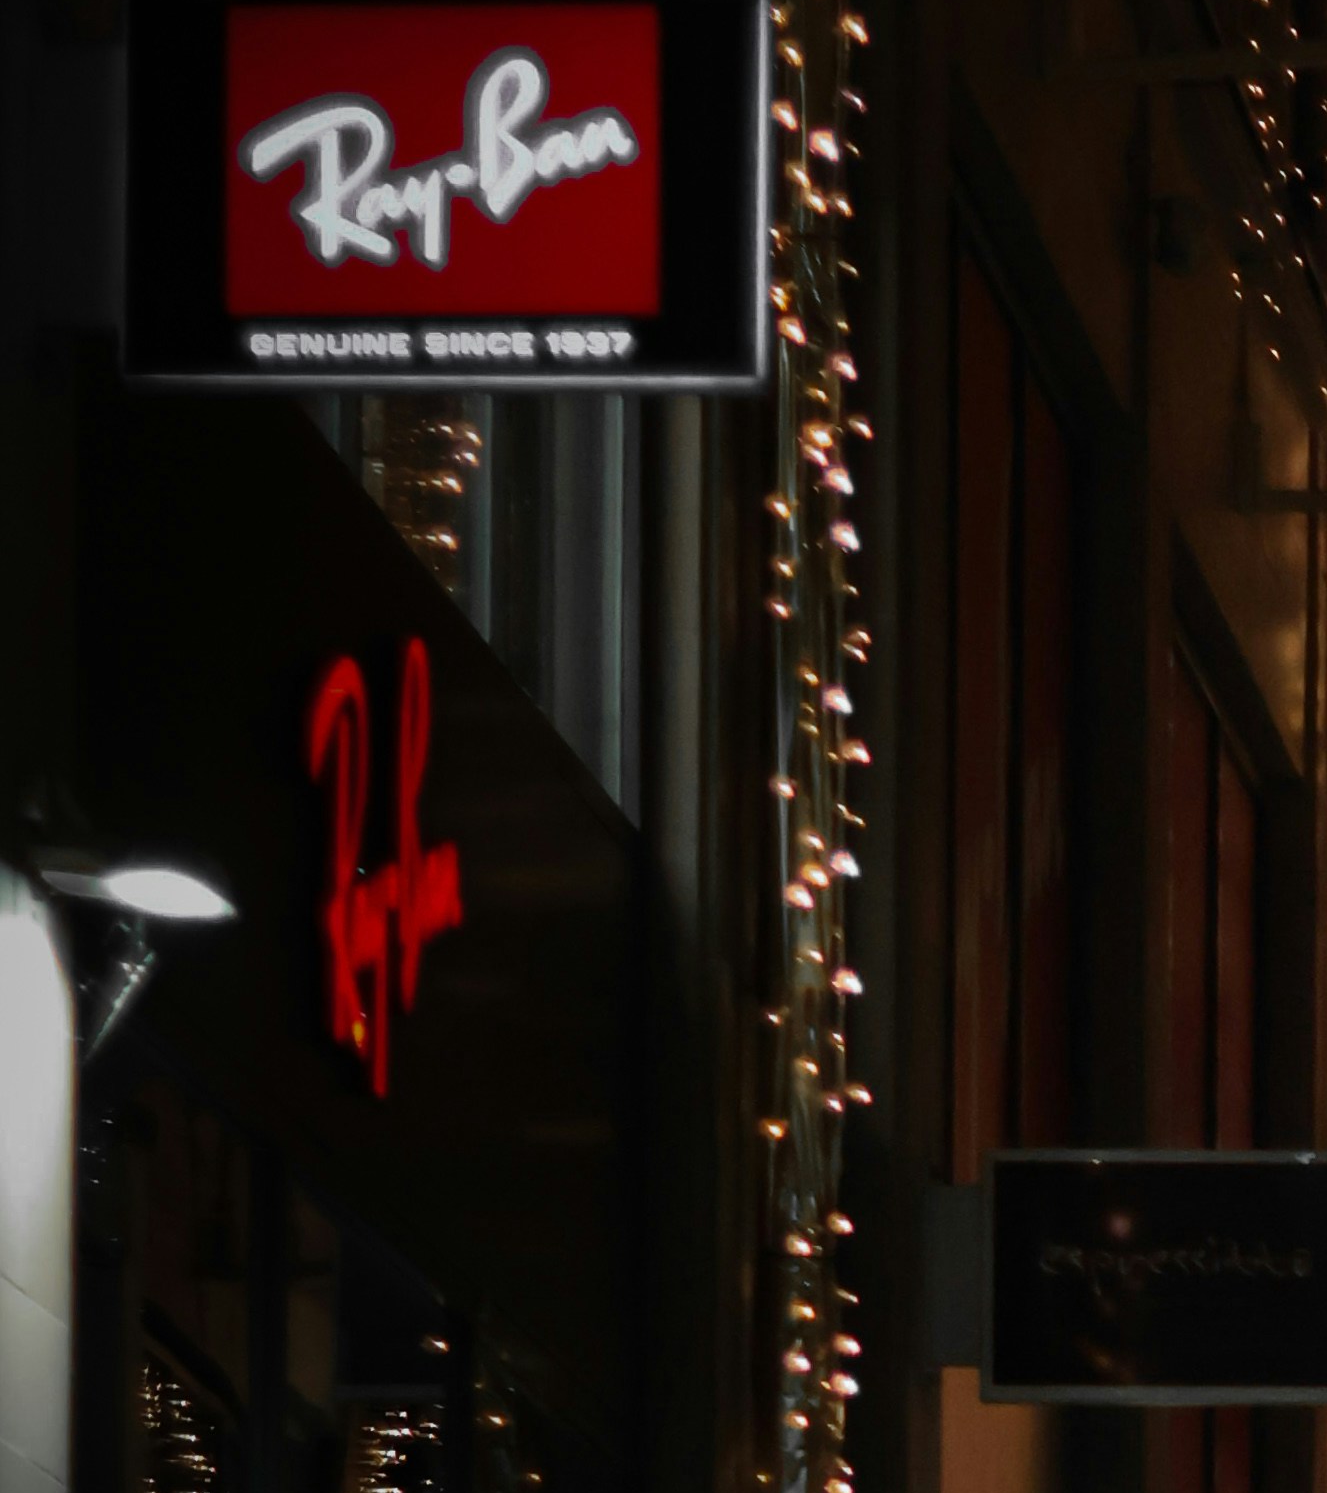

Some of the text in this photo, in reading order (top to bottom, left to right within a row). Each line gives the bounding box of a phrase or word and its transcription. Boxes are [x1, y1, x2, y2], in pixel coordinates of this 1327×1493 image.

[247, 54, 636, 265] Ray-Ban
[249, 332, 633, 358] GENUINE SINCE 1937
